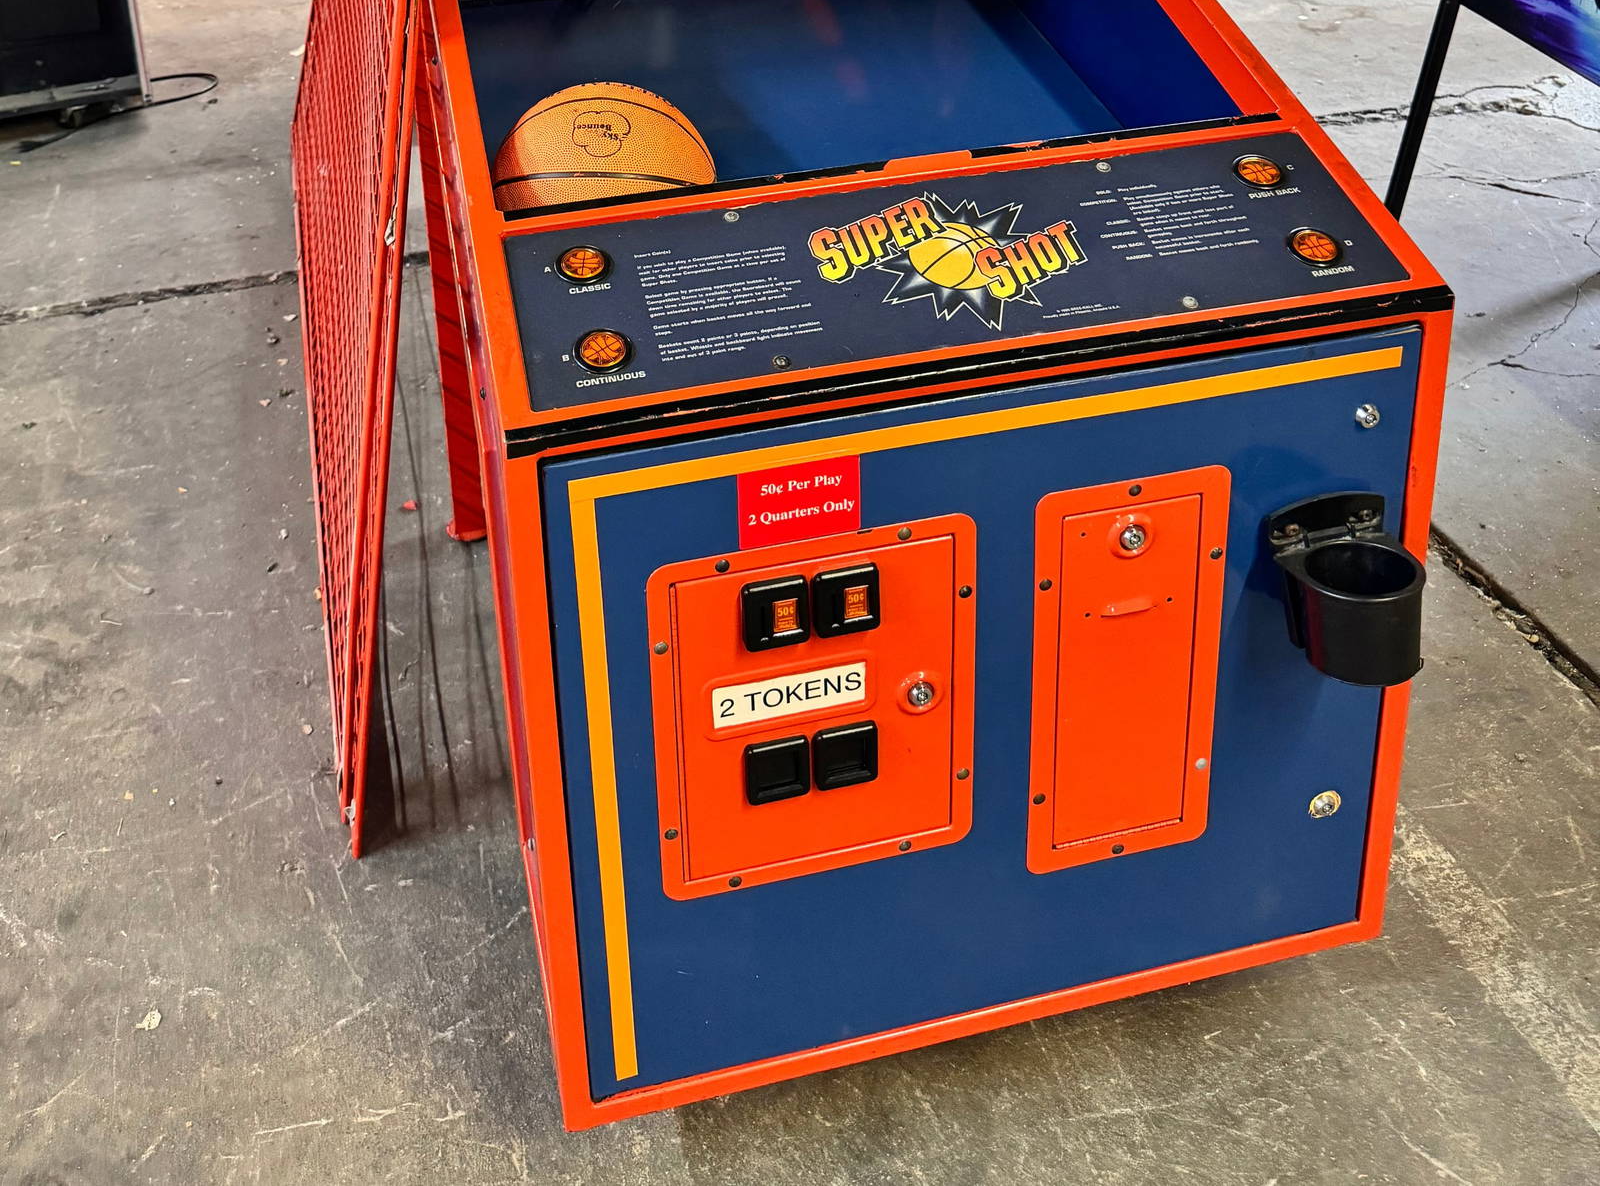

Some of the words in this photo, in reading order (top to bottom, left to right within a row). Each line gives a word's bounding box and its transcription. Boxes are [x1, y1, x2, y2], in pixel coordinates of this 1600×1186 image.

[577, 123, 612, 131] Bounce
[1248, 190, 1275, 200] PUSH
[1275, 186, 1302, 197] BACK
[808, 196, 947, 284] SUPER
[1344, 239, 1353, 247] D
[974, 220, 1088, 301] SHOT
[1311, 265, 1356, 278] RANDOM
[568, 283, 612, 295] CLASSIC
[561, 354, 570, 362] B
[575, 371, 647, 388] CONTINUOUS
[760, 483, 784, 496] 50¢
[787, 480, 811, 492] Per
[814, 475, 842, 487] Play
[748, 514, 757, 526] 2
[760, 506, 820, 525] Quarters
[823, 498, 855, 512] Only
[777, 606, 794, 617] 50¢
[720, 698, 735, 718] 2
[744, 671, 862, 711] TOKENS
